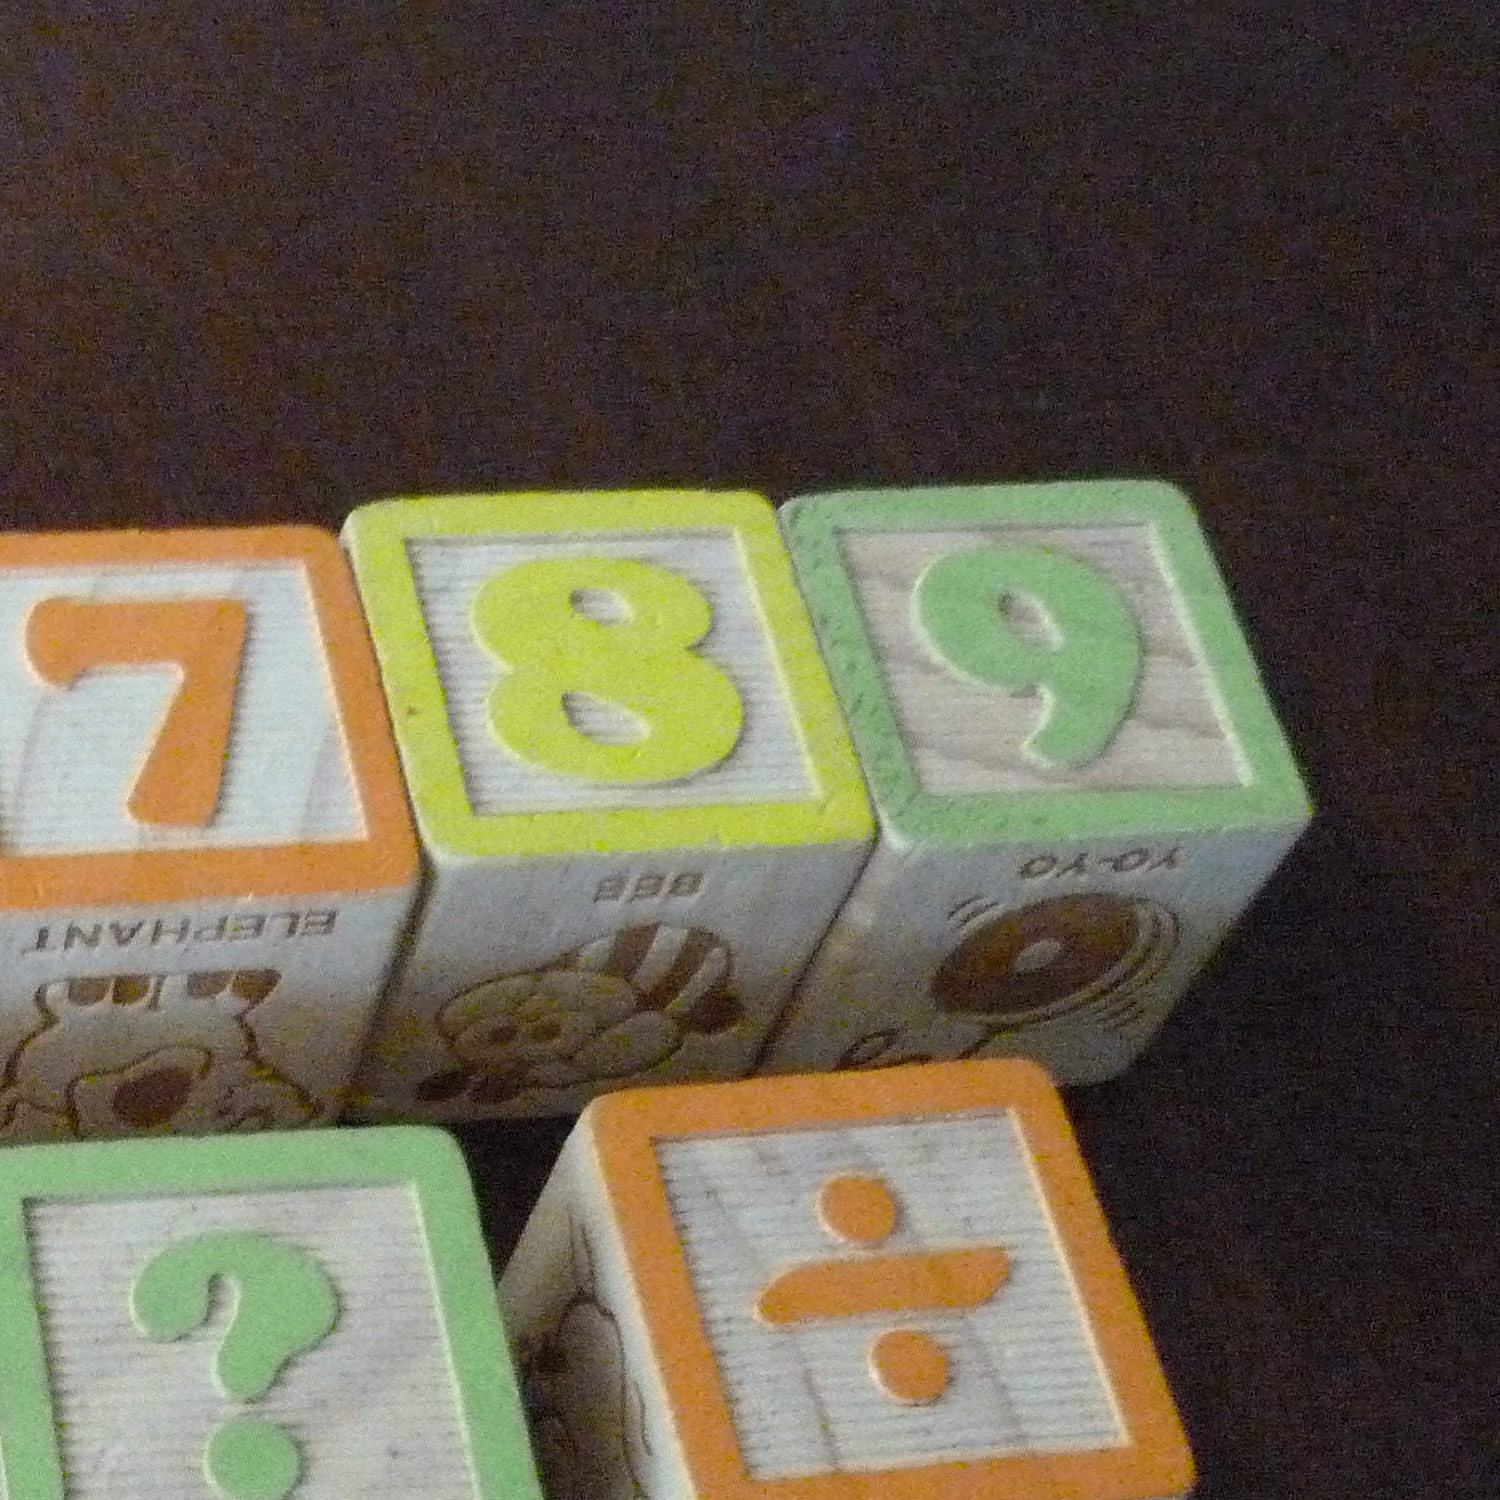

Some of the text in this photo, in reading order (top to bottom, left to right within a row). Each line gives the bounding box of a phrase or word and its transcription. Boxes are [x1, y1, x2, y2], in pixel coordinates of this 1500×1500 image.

[24, 596, 248, 828] 7
[472, 555, 746, 784] 8
[913, 543, 1144, 770] 9
[593, 870, 705, 905] BEE
[1019, 845, 1183, 881] YO-YO
[23, 908, 339, 956] ELEPHANT
